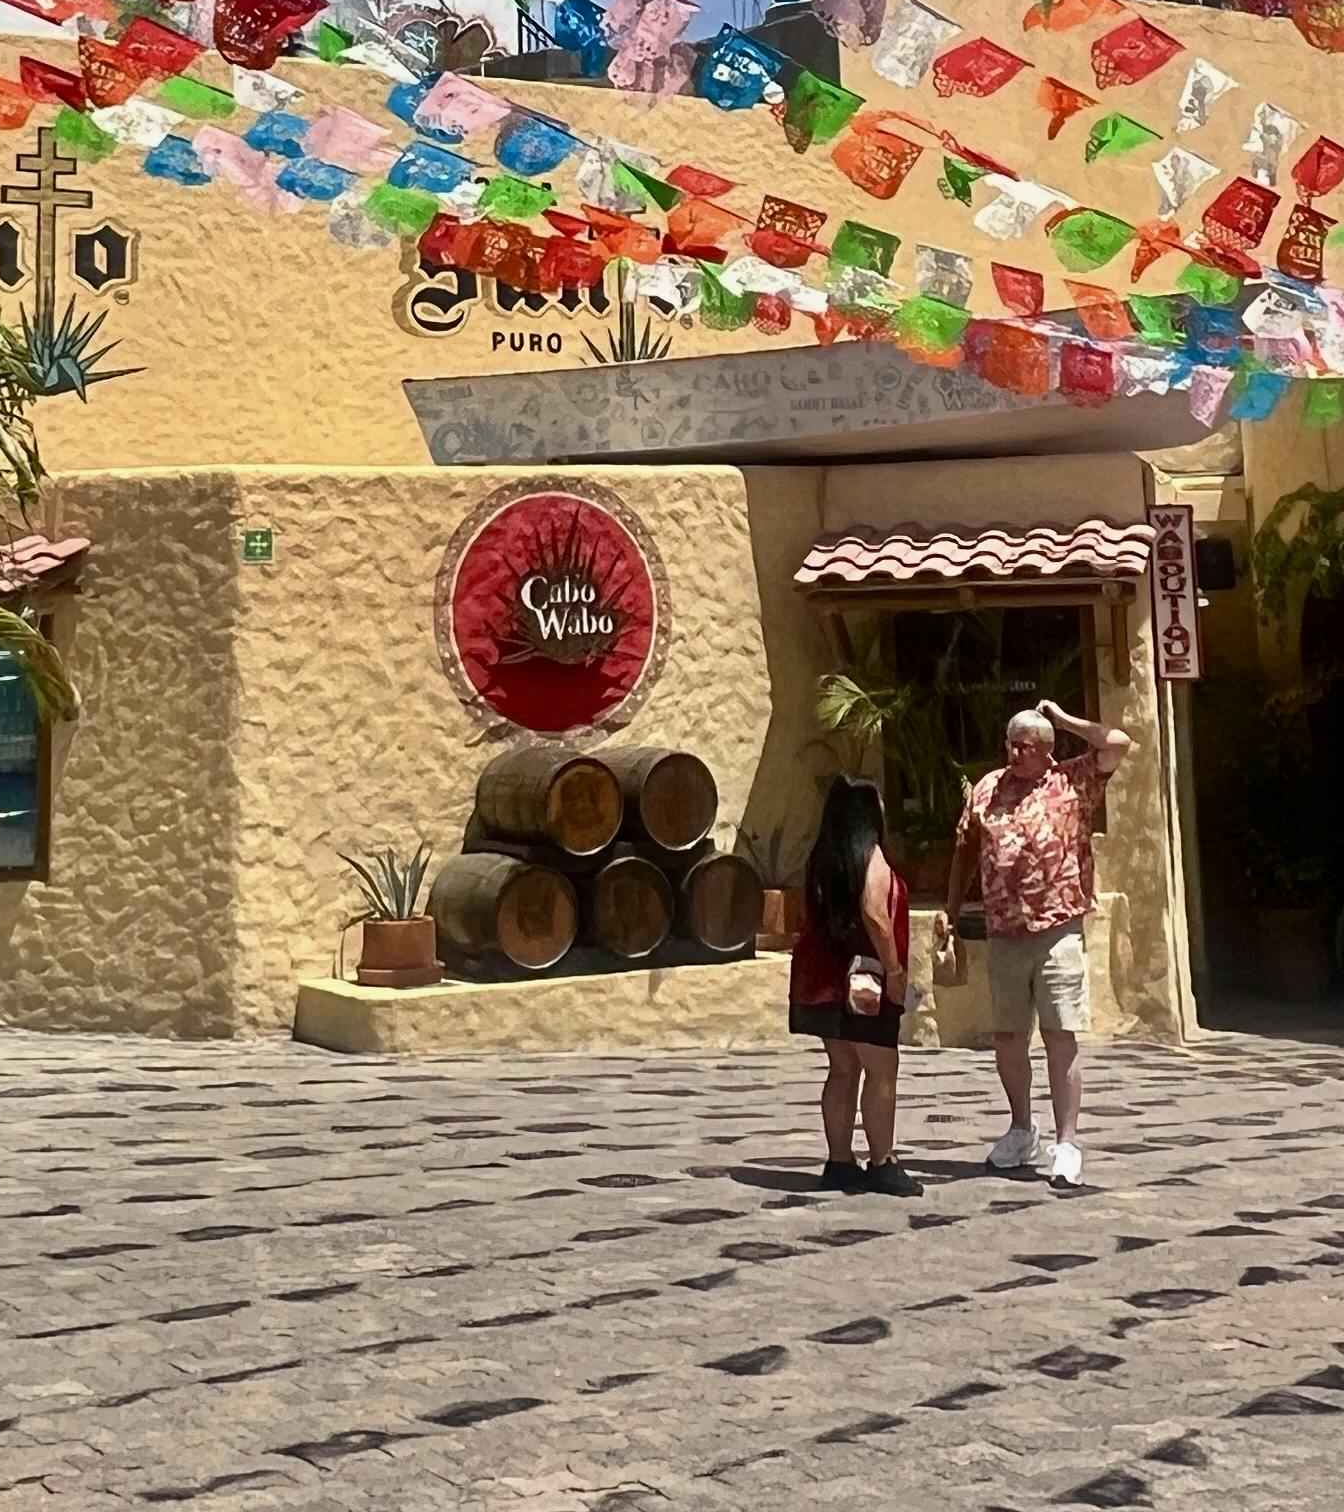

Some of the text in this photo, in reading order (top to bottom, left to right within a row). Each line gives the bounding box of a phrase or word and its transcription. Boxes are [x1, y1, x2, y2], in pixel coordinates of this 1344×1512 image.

[492, 331, 563, 355] PURO
[520, 574, 596, 610] Cabo
[1154, 513, 1191, 674] WABOUTIQUE
[535, 607, 614, 641] Wabo
